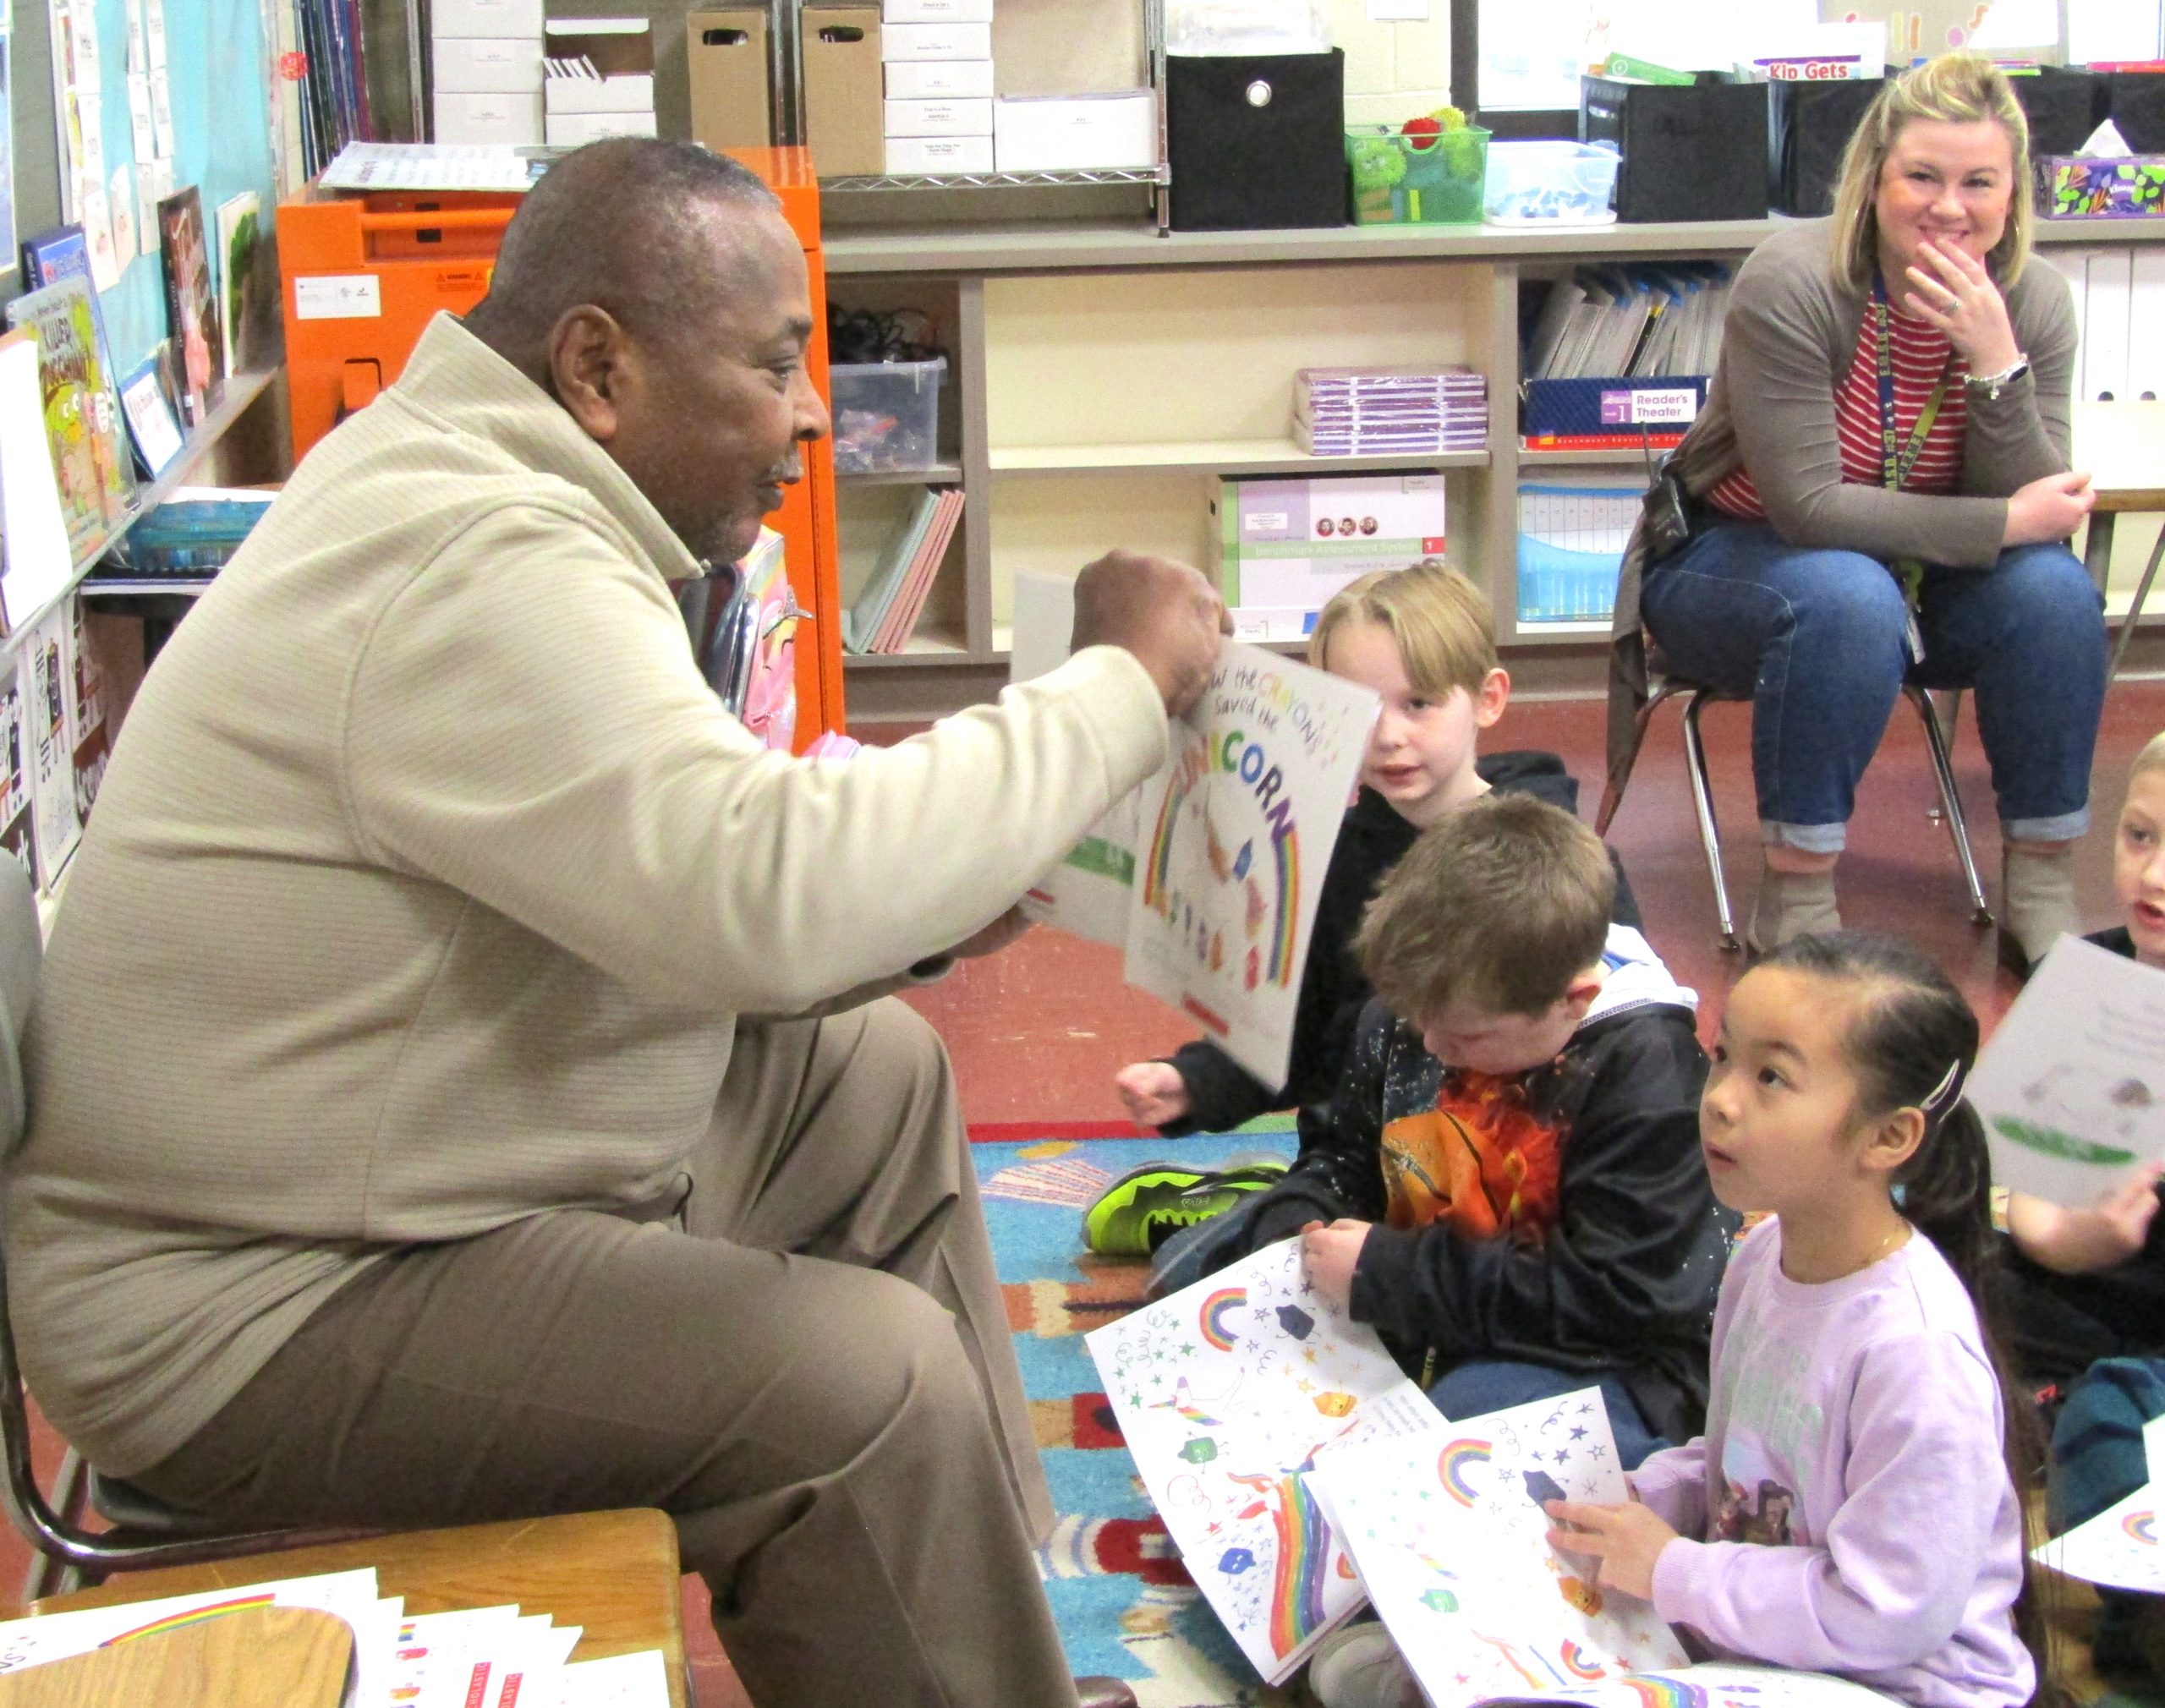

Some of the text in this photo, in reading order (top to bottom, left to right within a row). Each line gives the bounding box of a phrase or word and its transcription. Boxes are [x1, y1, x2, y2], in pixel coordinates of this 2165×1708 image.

[1805, 63, 1847, 79] Gets
[1636, 395, 1688, 404] Reader's
[1619, 406, 1625, 422] 1
[1637, 407, 1681, 418] Theater
[1316, 543, 1378, 555] Assessment
[1381, 541, 1418, 554] System
